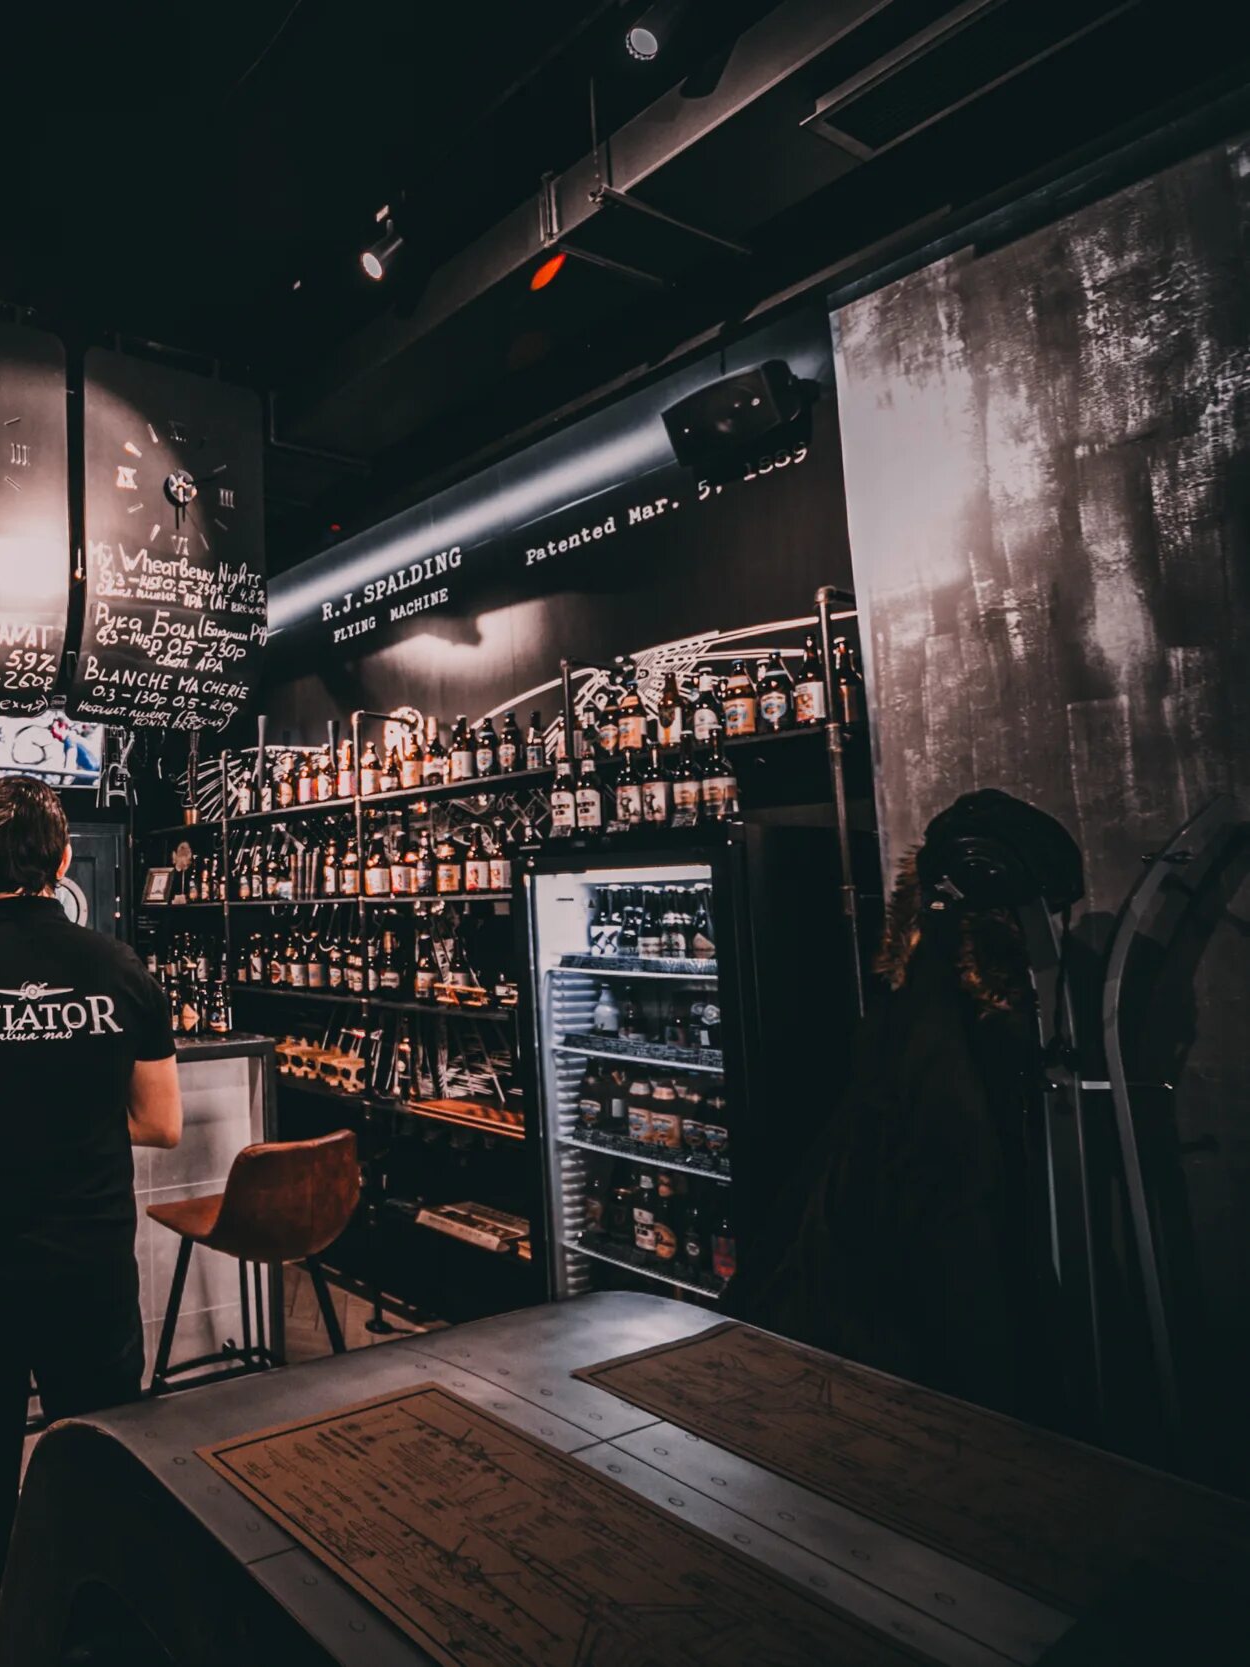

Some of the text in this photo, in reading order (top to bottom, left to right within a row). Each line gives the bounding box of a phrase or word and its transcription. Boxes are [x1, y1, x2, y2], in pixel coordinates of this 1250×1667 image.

[525, 517, 616, 566] Patented
[628, 498, 680, 526] Mar.
[697, 479, 723, 500] 5,
[333, 588, 449, 643] FLYING MACHINE
[84, 655, 173, 690] BLANCHE
[178, 676, 198, 693] MA
